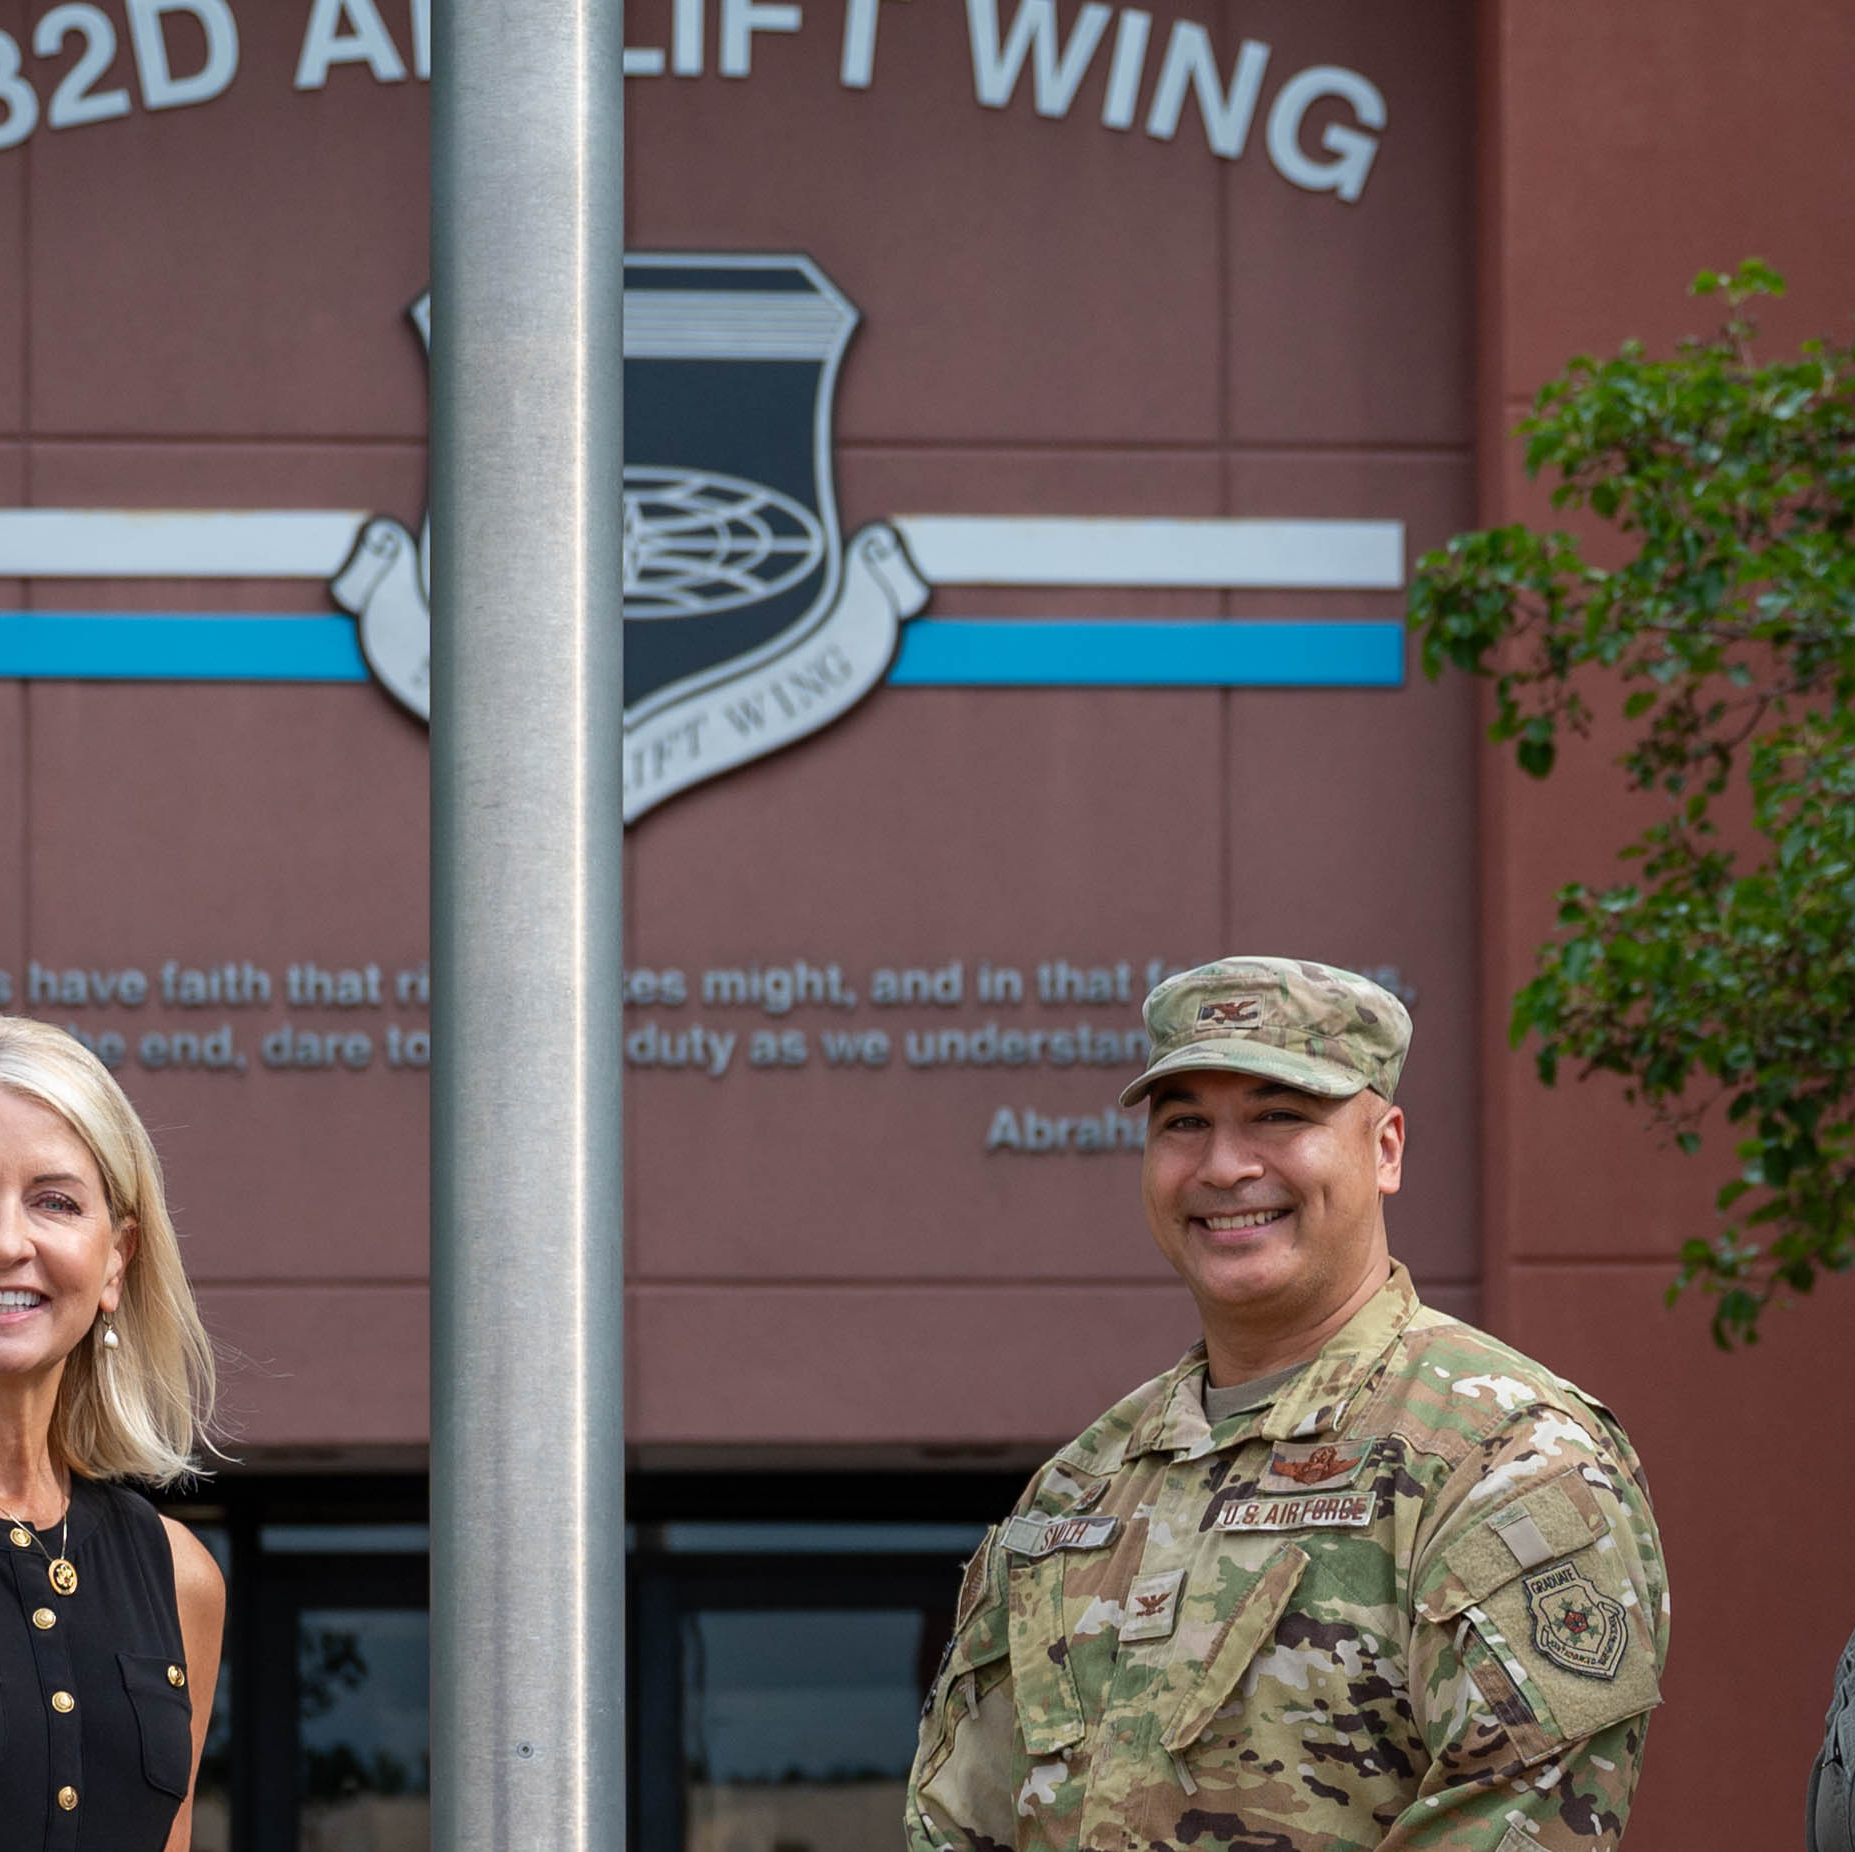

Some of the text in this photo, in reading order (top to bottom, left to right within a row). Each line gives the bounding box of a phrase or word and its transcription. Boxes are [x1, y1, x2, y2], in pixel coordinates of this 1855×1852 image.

[292, 0, 876, 90] AIIFT
[965, 0, 1387, 202] WING
[722, 644, 854, 737] WING
[28, 959, 146, 1006] have
[160, 959, 271, 1005] faith
[286, 961, 381, 1005] that
[701, 959, 857, 1015] might,
[871, 960, 963, 1005] and
[977, 961, 1023, 1005] in
[1037, 959, 1132, 1005] that
[139, 1022, 247, 1072] end,
[261, 1022, 372, 1068] dare
[386, 1024, 430, 1068] to
[627, 1022, 735, 1077] duty
[750, 1030, 808, 1066] as
[820, 1030, 890, 1066] we
[905, 1021, 1150, 1066] understan
[1223, 1497, 1369, 1525] U.S. AIR FORCE
